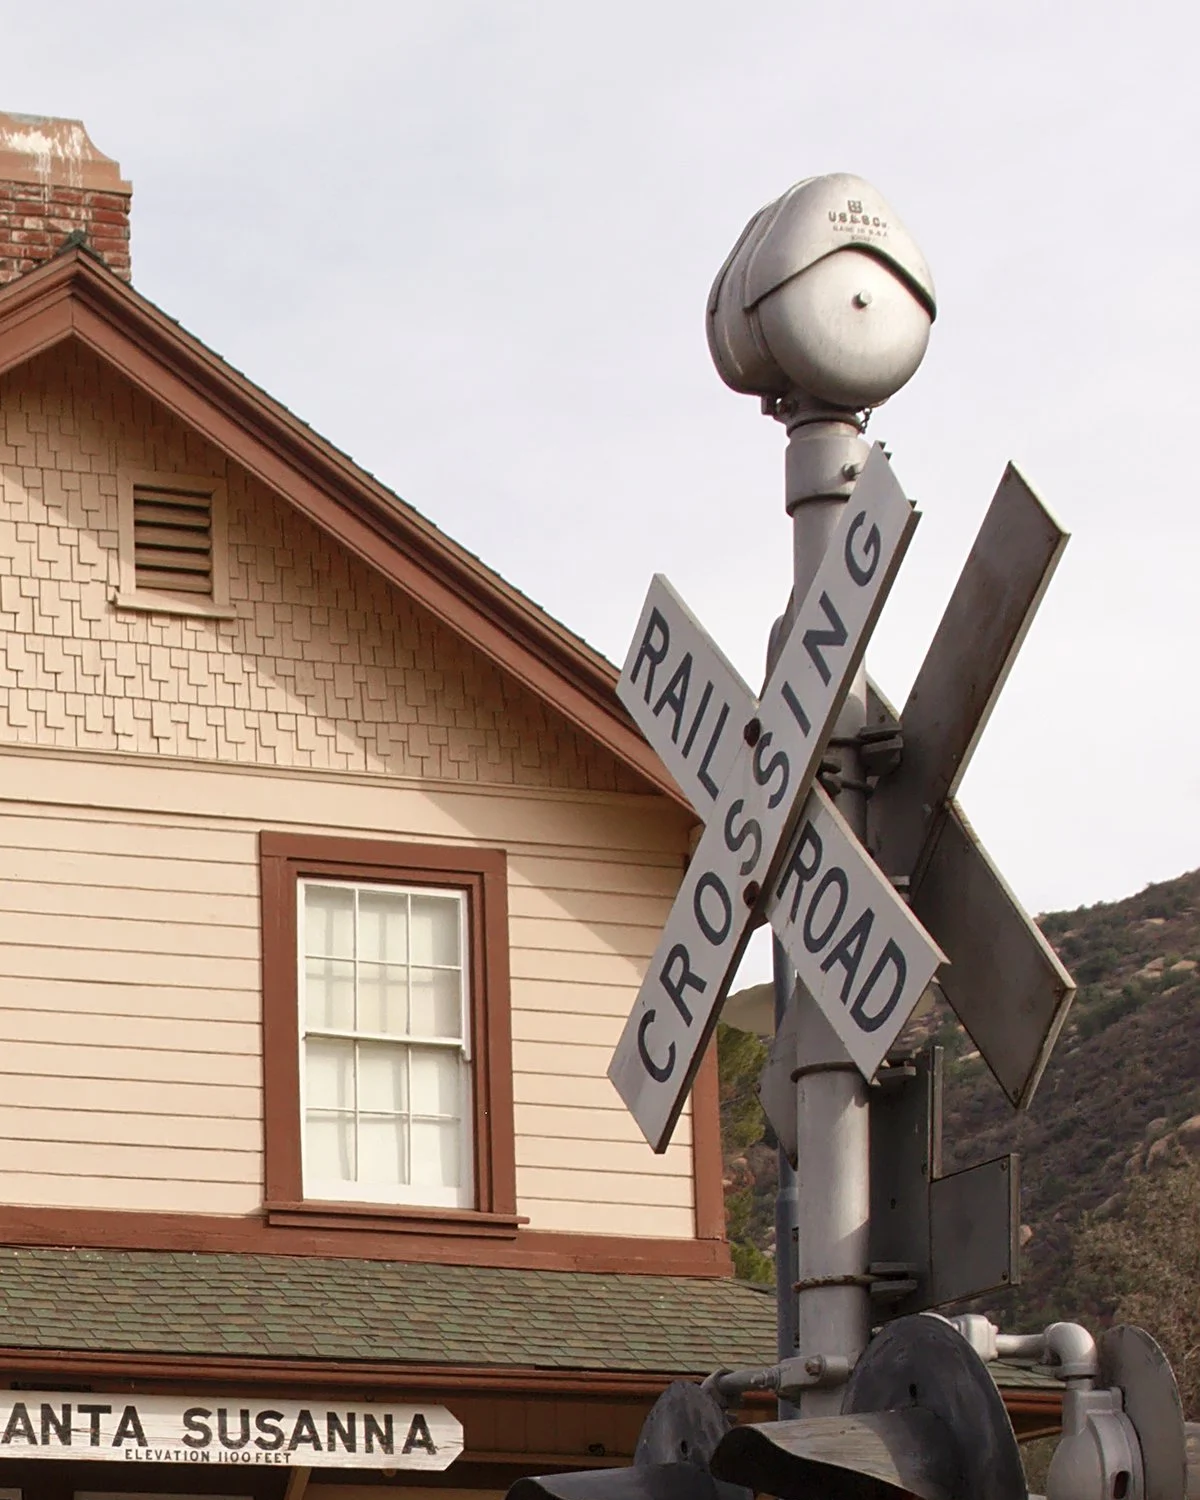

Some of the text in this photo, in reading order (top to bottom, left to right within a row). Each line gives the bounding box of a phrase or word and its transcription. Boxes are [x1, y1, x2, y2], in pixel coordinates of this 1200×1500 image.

[629, 606, 909, 1034] RAIL ROAD
[636, 510, 882, 1083] CROSSING
[125, 1448, 292, 1465] ELEVATION 1100 FEET
[181, 1406, 438, 1454] SUSANNA
